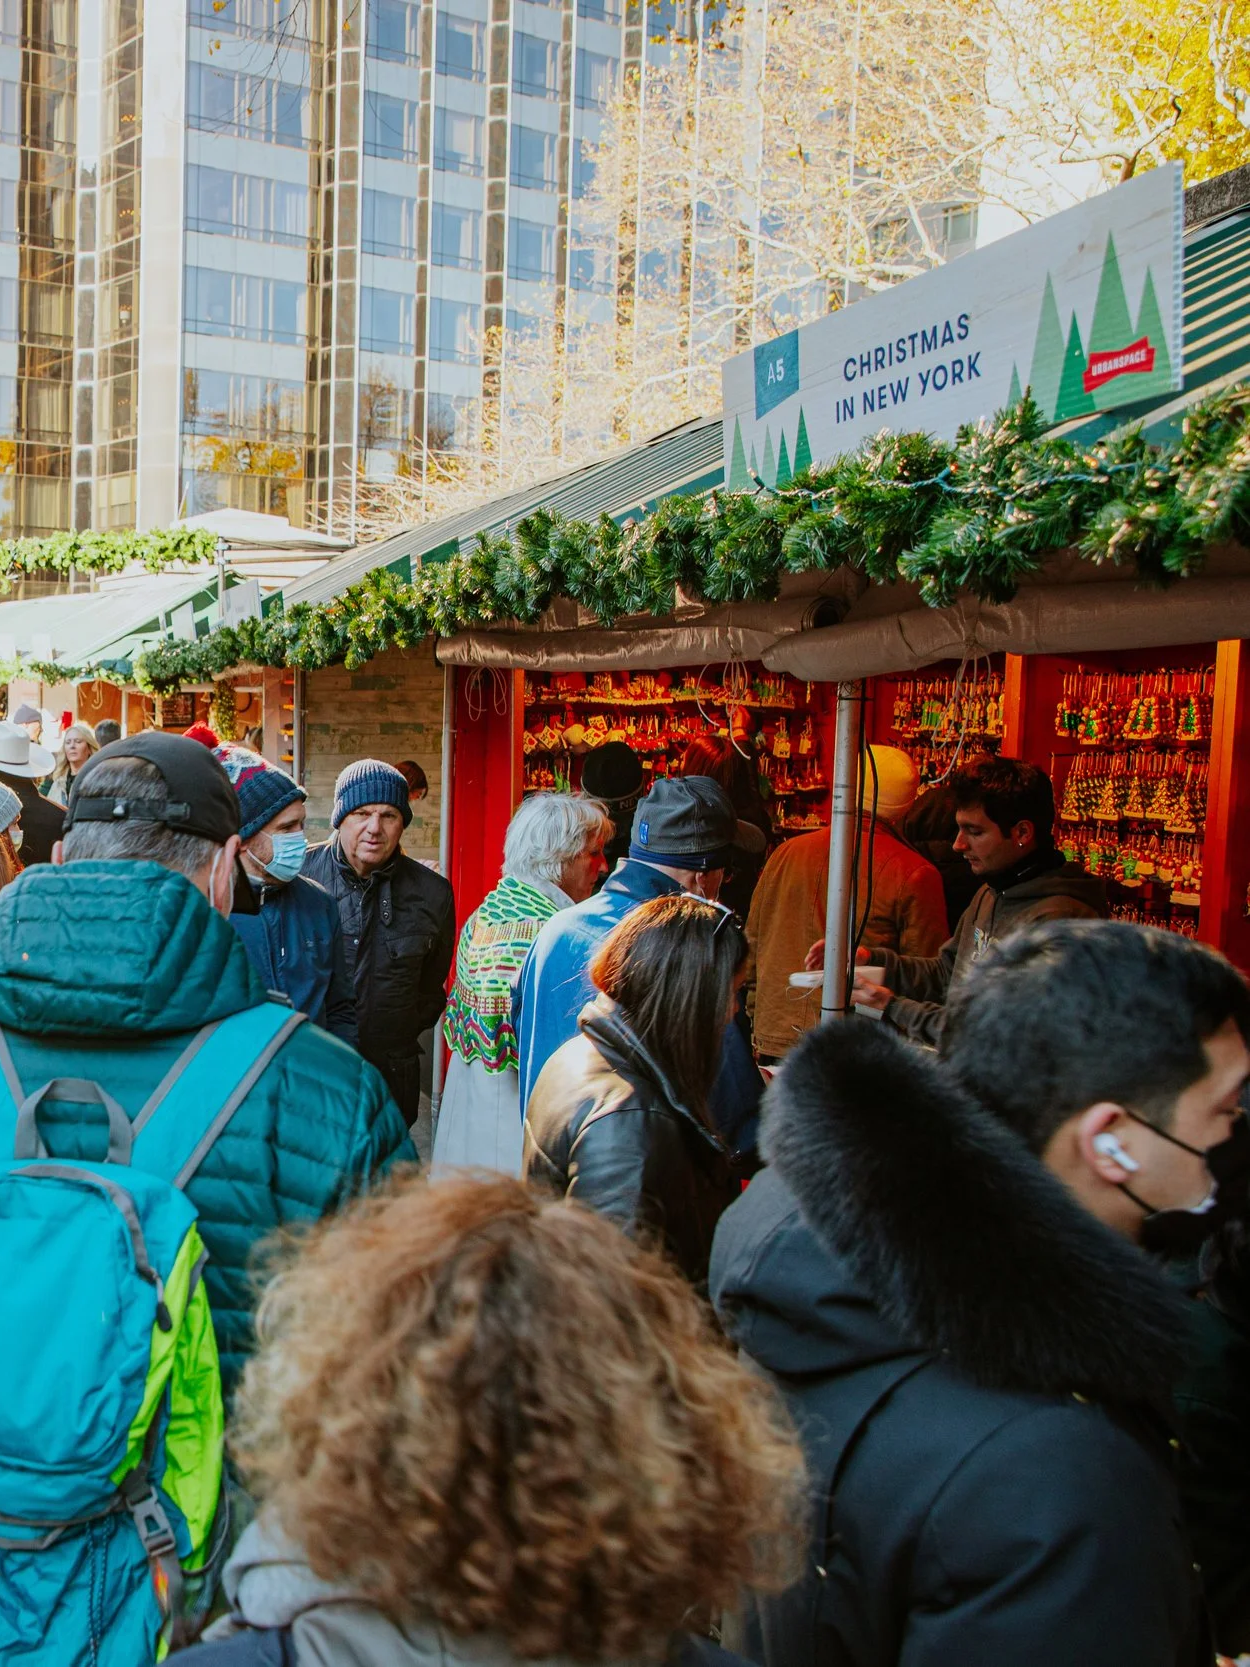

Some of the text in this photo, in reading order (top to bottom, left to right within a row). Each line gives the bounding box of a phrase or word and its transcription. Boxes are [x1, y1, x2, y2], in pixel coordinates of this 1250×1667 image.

[767, 357, 785, 386] A5
[843, 313, 970, 382] CHRISTMAS
[1091, 348, 1148, 377] URBANSPACE
[836, 351, 981, 424] IN NEW YORK
